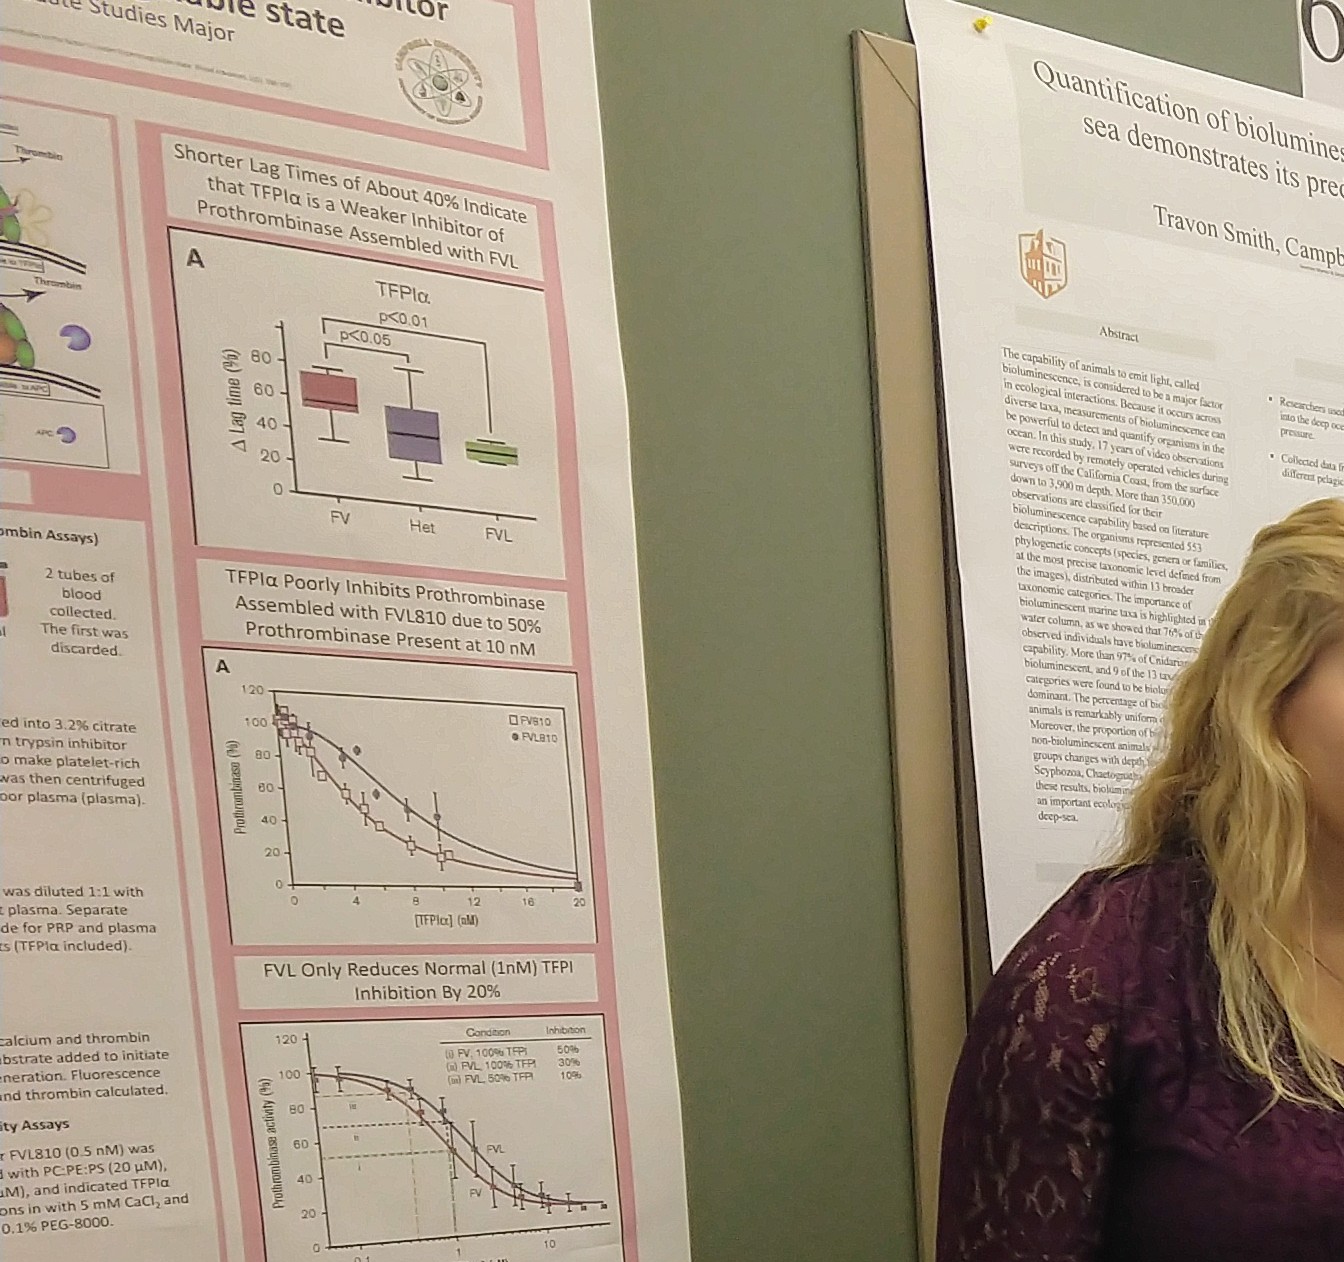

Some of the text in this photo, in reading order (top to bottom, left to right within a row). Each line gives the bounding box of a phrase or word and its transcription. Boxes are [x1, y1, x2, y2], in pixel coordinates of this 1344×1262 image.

[89, 0, 166, 27] Studies
[174, 14, 234, 41] Major
[266, 2, 344, 37] state
[1033, 60, 1200, 124] Quantification
[1206, 109, 1230, 132] of
[1083, 116, 1120, 141] sea
[1127, 122, 1268, 180] demonstrates
[1275, 160, 1299, 188] its
[174, 143, 527, 223] Shorter Lag Times of About 40% Indicate
[207, 175, 245, 196] that
[306, 192, 320, 209] is
[325, 199, 335, 211] a
[339, 198, 407, 224] Weaker
[411, 212, 483, 238] Inhibitor
[488, 227, 504, 242] of
[197, 199, 518, 269] Prothrombinase Assembled with FVL
[1152, 204, 1218, 238] Travon
[1223, 221, 1280, 255] Smith,
[186, 248, 205, 268] A
[379, 311, 427, 328] p<0.01
[340, 329, 391, 346] p<0.05
[1099, 326, 1139, 343] Abstract
[250, 349, 271, 364] 80
[1001, 346, 1199, 391] The capability of animals to emit light, called
[253, 382, 274, 397] 60
[256, 416, 277, 430] 40
[260, 448, 280, 463] 20
[273, 482, 283, 495] 0
[330, 510, 350, 524] FV
[409, 518, 435, 534] Het
[485, 527, 513, 542] FVL
[45, 567, 114, 583] 2 tubes of
[284, 573, 340, 595] Poorly
[346, 579, 410, 598] Inhibits
[415, 585, 545, 610] Prothrombinase
[235, 595, 541, 633] Assembled with FVL810 due to 50%
[40, 622, 128, 639] The first was
[246, 621, 535, 656] Prothrombinase Present at 10 nM
[215, 659, 230, 673] A
[263, 959, 573, 980] FVL Only Reduces Normal (1nM) TFPI
[355, 984, 502, 1007] Inhibition By 20%
